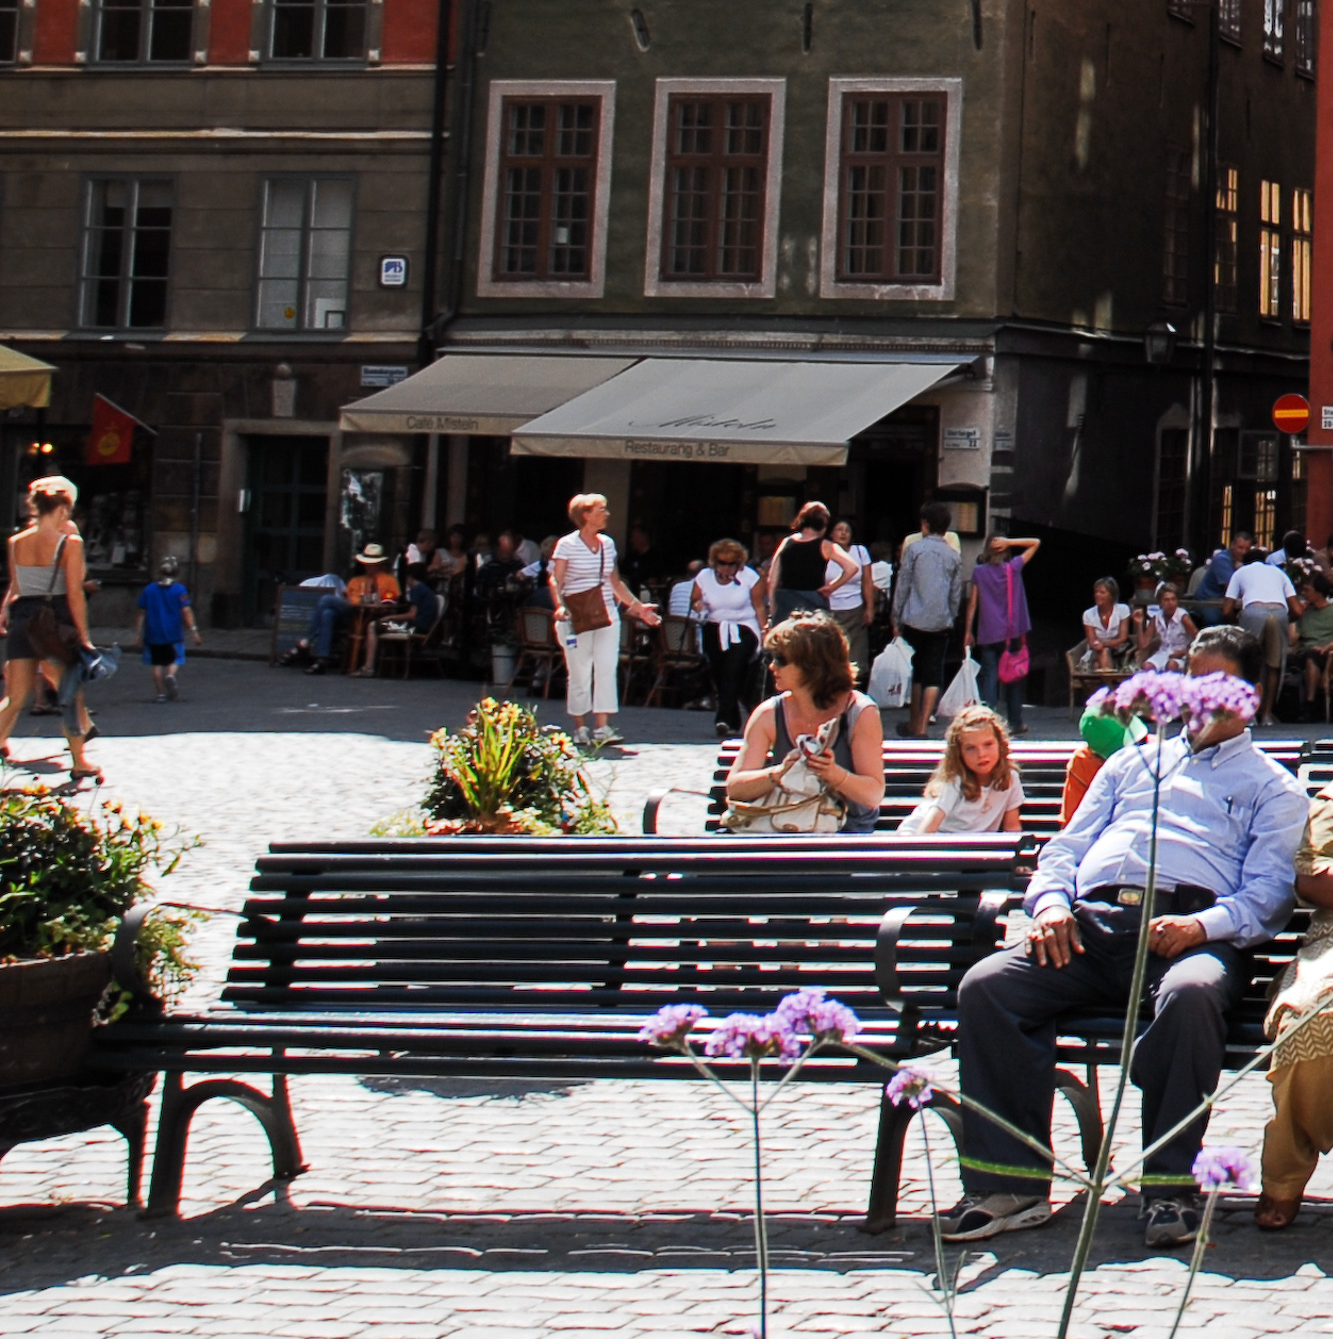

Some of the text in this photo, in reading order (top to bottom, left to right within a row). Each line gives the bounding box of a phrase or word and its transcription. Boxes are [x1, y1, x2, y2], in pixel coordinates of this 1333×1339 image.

[406, 416, 434, 430] Café
[624, 440, 730, 458] Restaurang & Bar
